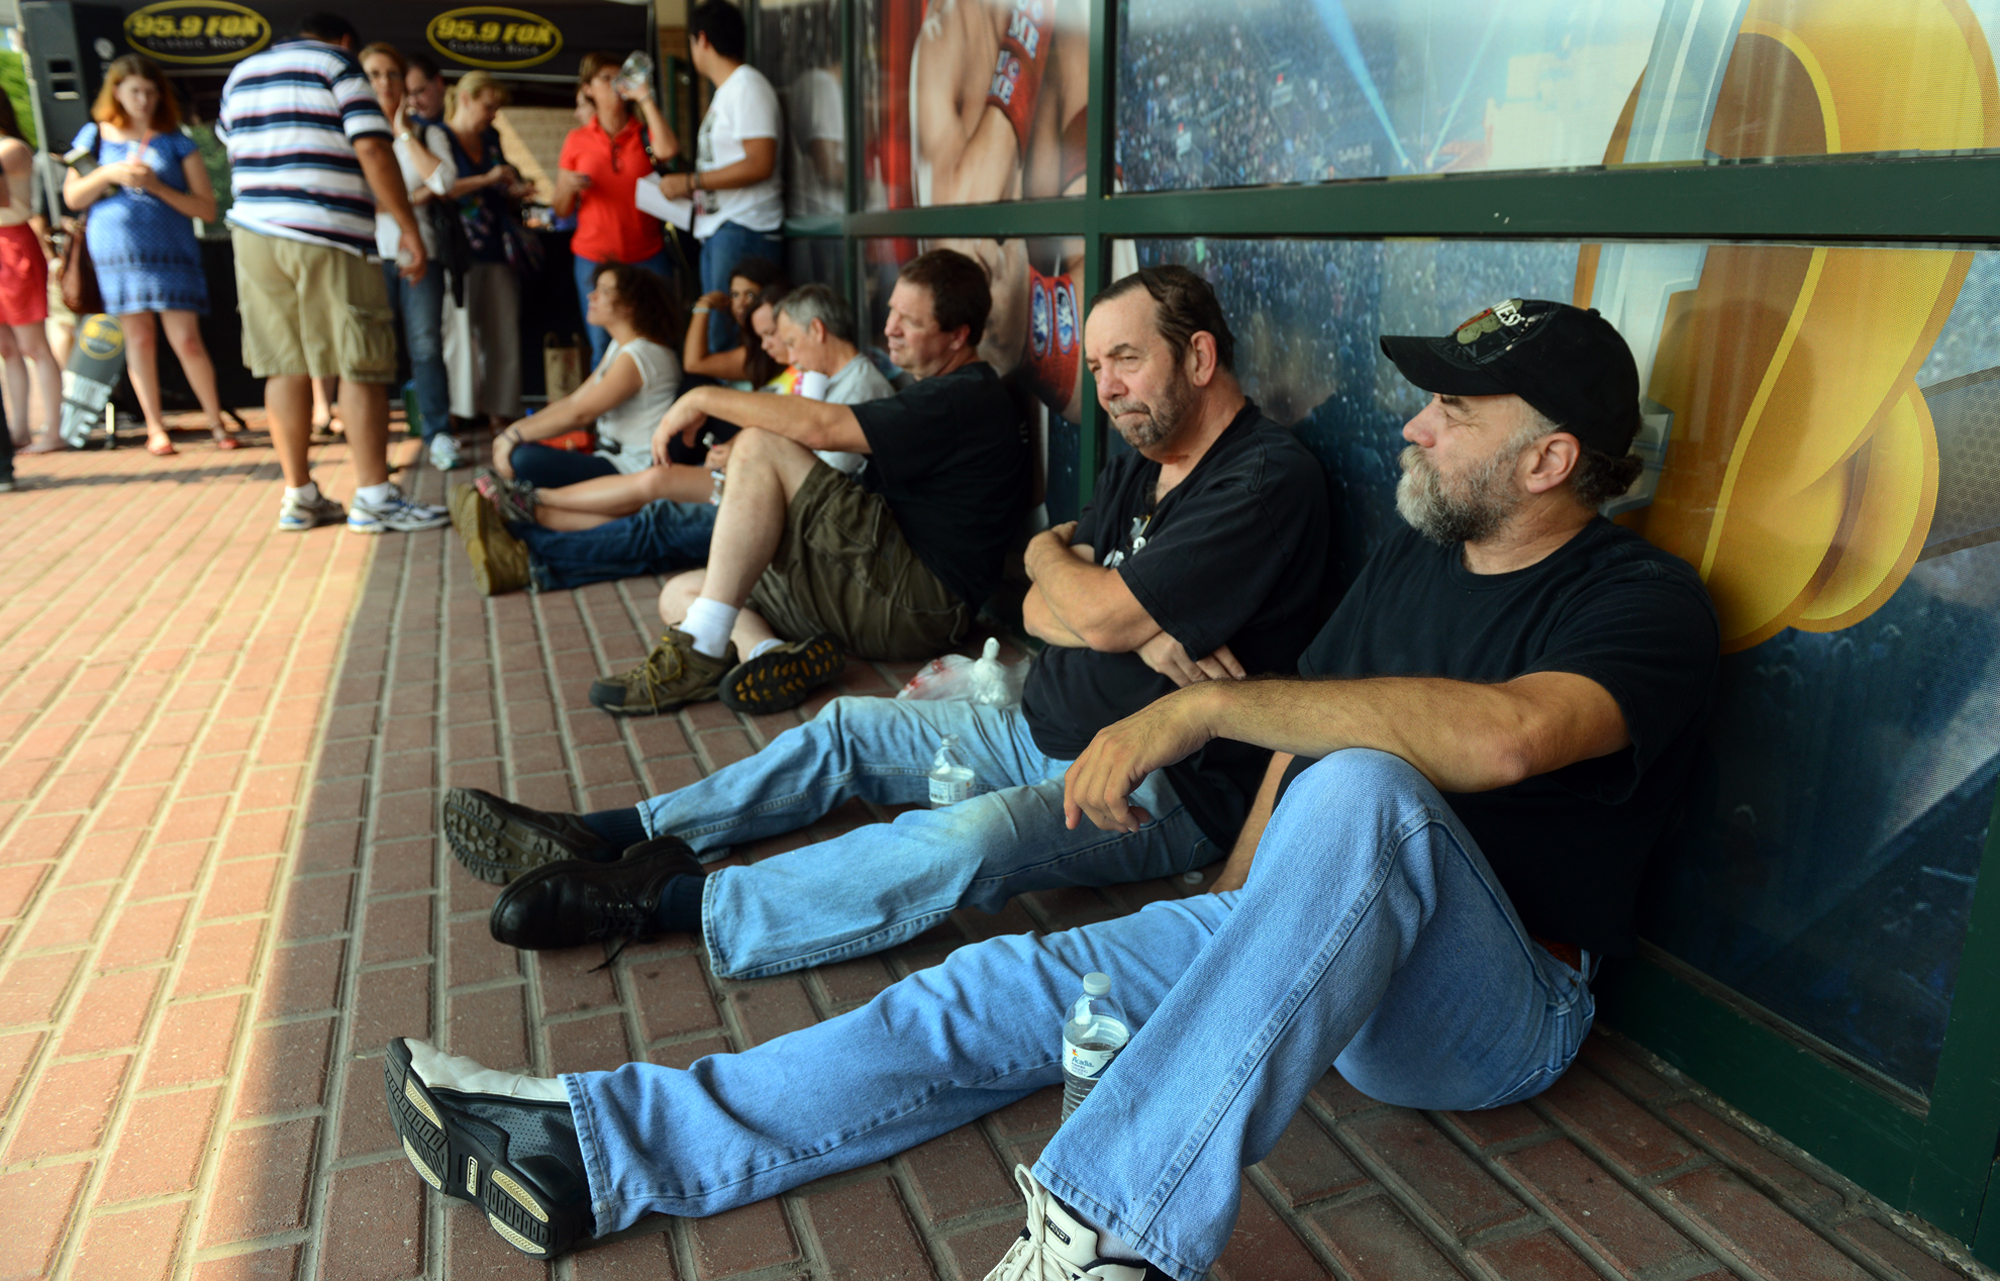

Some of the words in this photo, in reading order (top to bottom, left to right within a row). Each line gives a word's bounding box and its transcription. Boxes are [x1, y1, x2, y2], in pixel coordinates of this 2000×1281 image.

[131, 14, 204, 38] 95.9
[205, 14, 259, 38] FOX
[436, 17, 501, 43] 95.9
[502, 22, 552, 46] FOX
